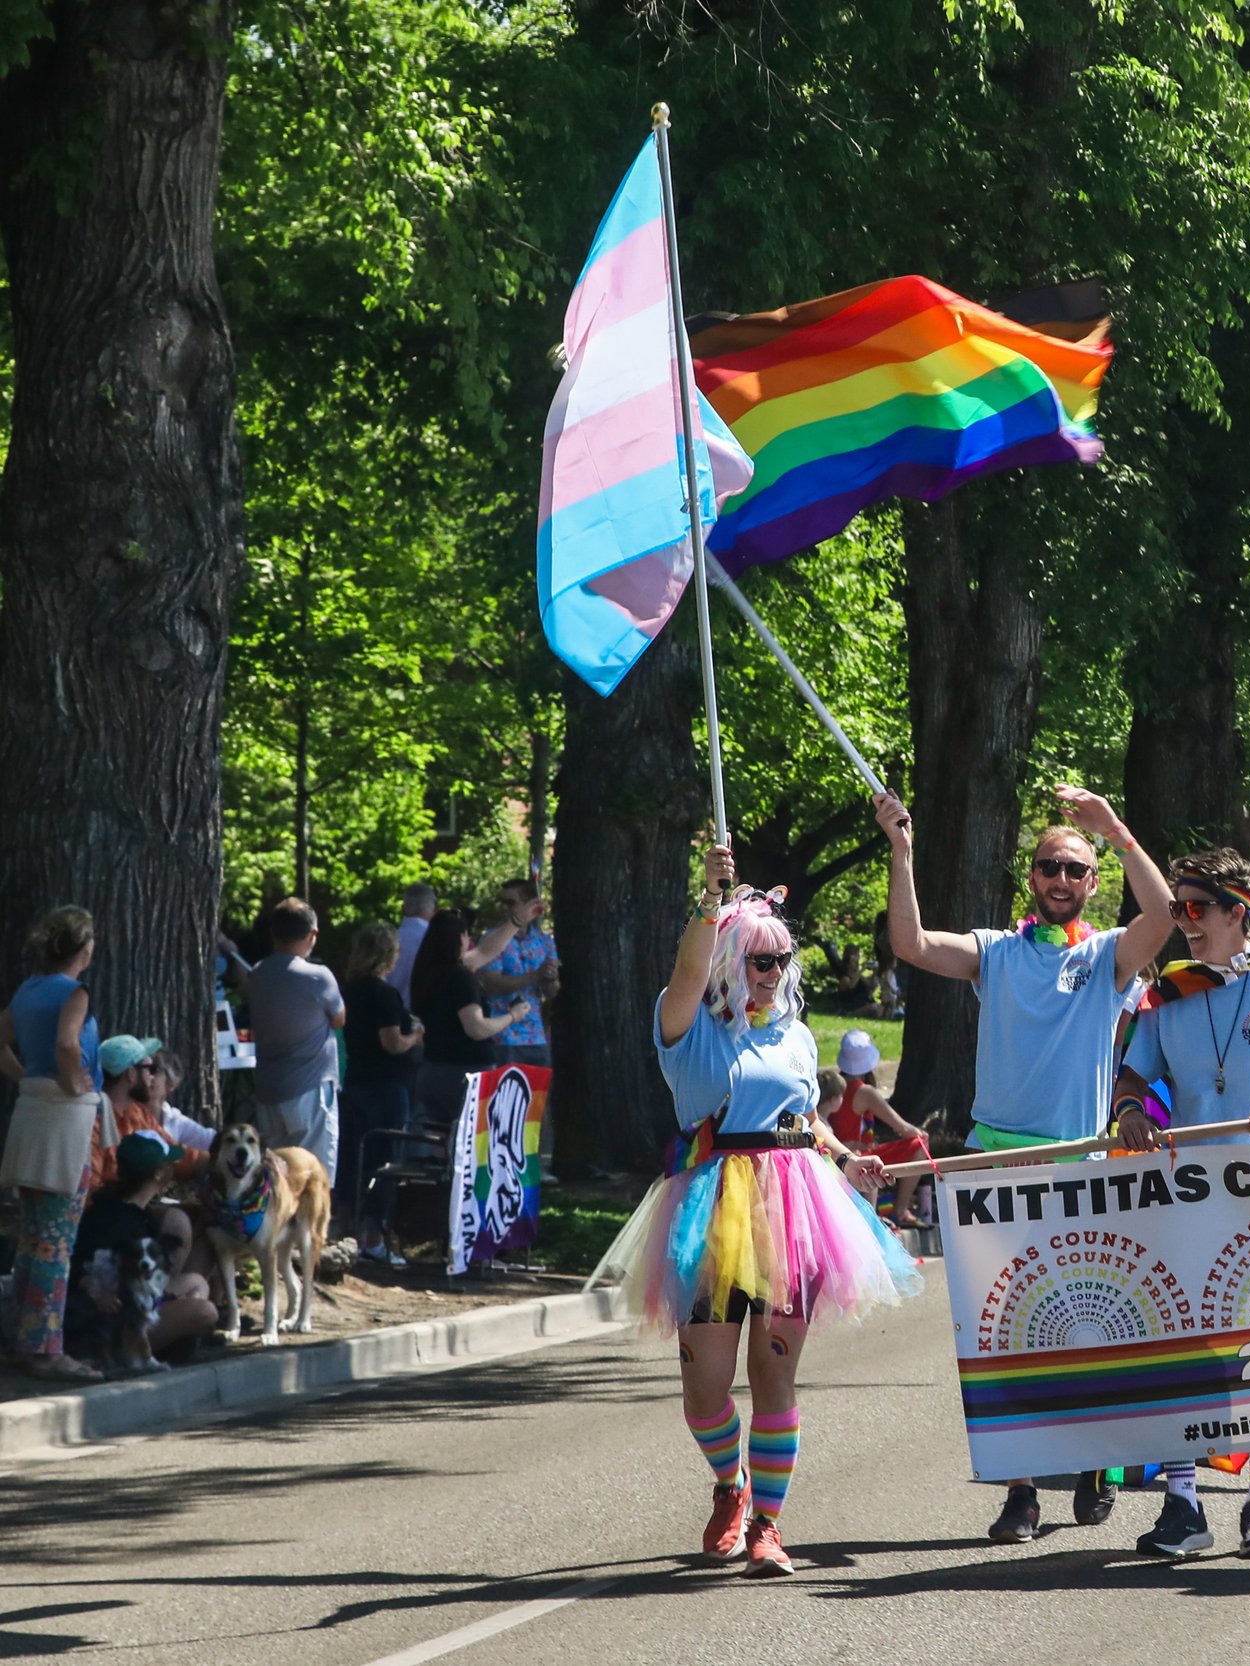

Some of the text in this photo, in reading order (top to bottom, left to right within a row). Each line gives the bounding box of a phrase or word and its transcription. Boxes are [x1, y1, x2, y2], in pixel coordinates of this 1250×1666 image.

[956, 1160, 1211, 1226] KITTITAS
[979, 1231, 1195, 1352] KITTITAS COUNTY PRIDE
[998, 1251, 1176, 1351] KITTITAS COUNTY PRIDE
[1013, 1277, 1055, 1350] KITTITAS
[1061, 1267, 1130, 1288] COUNTY
[1133, 1288, 1161, 1336] PRIDE
[1027, 1289, 1061, 1349] KITTITAS
[1066, 1281, 1122, 1298] COUNTY
[1124, 1298, 1147, 1338] PRIDE
[1038, 1300, 1066, 1347] KITTITAS
[1069, 1293, 1115, 1307] COUNTY
[1117, 1307, 1136, 1339] PRIDE
[1047, 1308, 1069, 1346] KITTITAS
[1072, 1302, 1109, 1313] COUNTY
[1075, 1310, 1104, 1319] COUNTY
